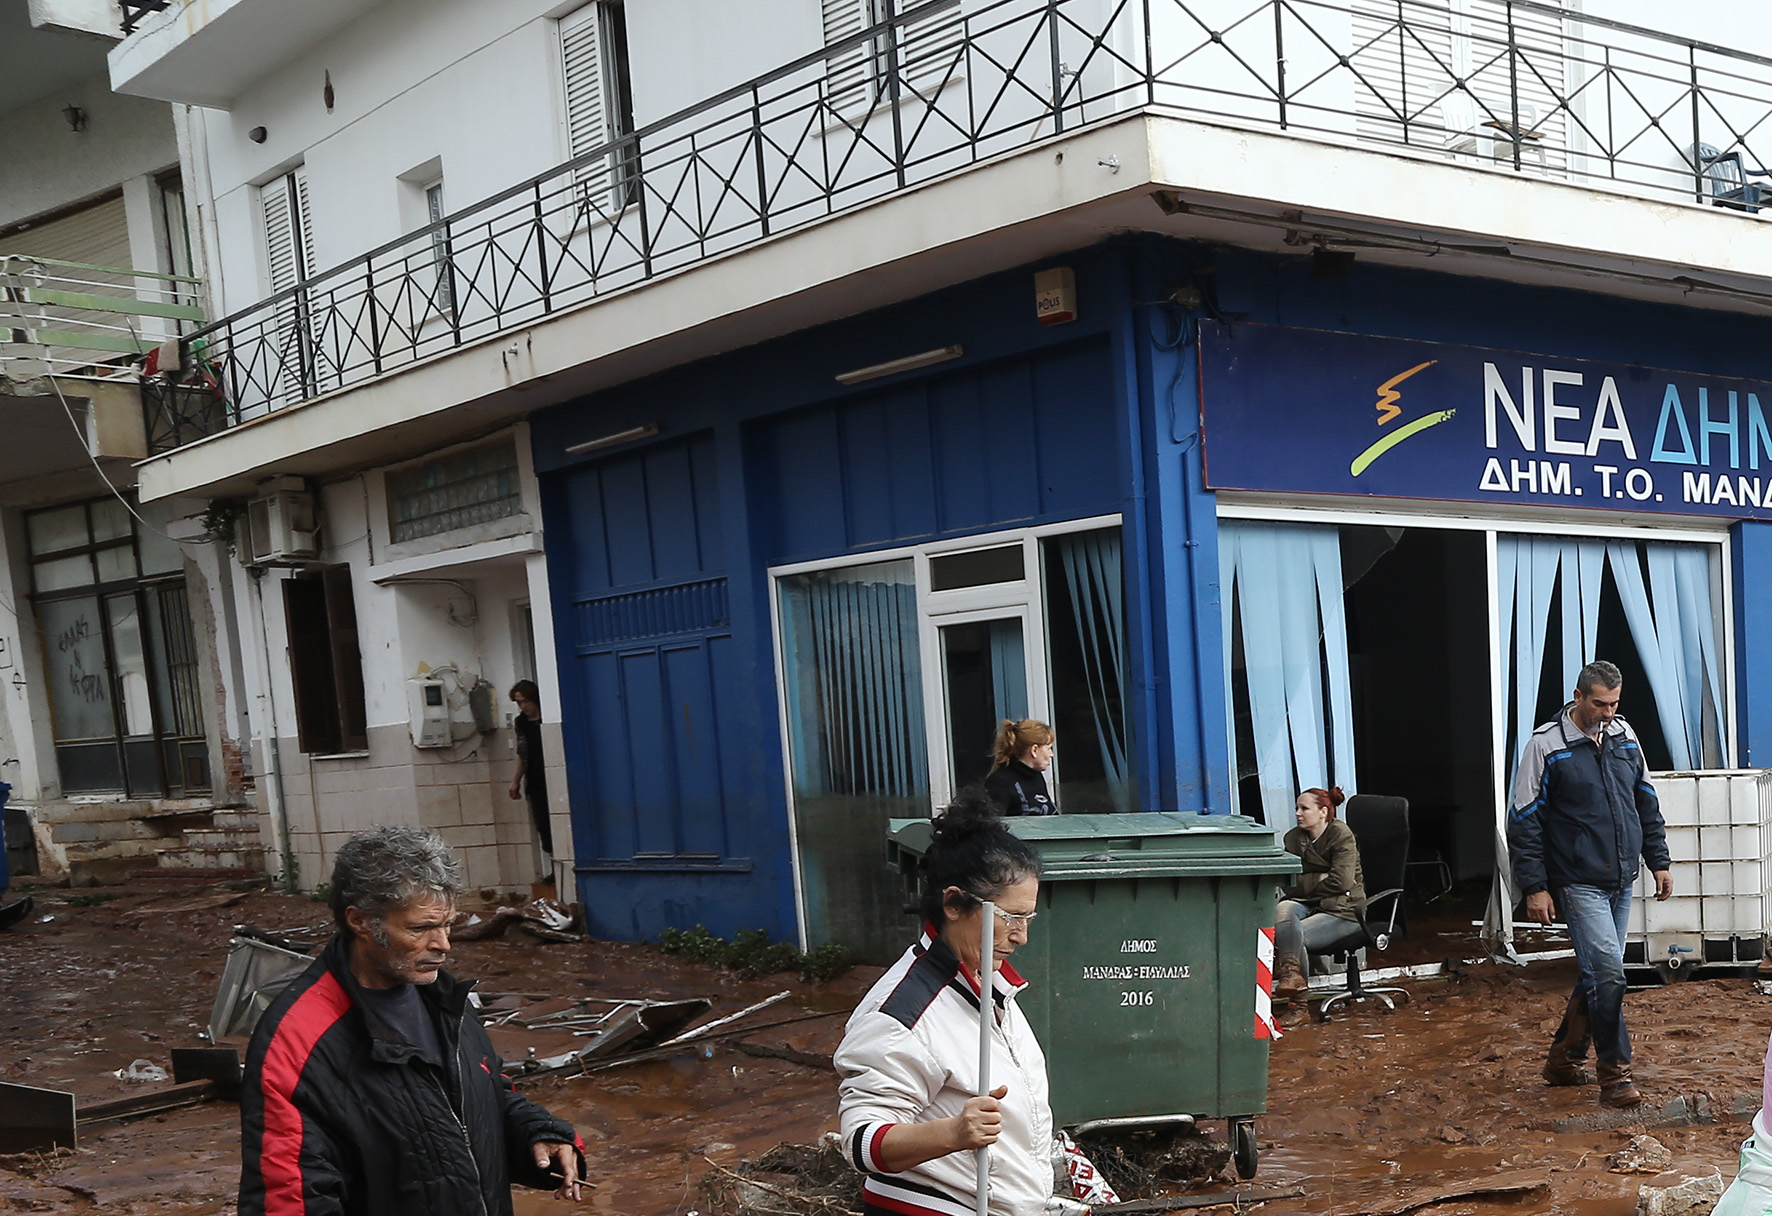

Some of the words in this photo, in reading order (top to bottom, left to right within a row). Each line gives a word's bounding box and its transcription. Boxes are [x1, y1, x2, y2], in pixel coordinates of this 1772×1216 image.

[1483, 362, 1638, 460] ΝΕΑ
[1479, 457, 1584, 495] ΔΗΜ.
[1593, 465, 1664, 501] Τ.Ο.
[1120, 939, 1157, 953] ΔΗΜΟΣ
[1120, 991, 1154, 1006] 2016
